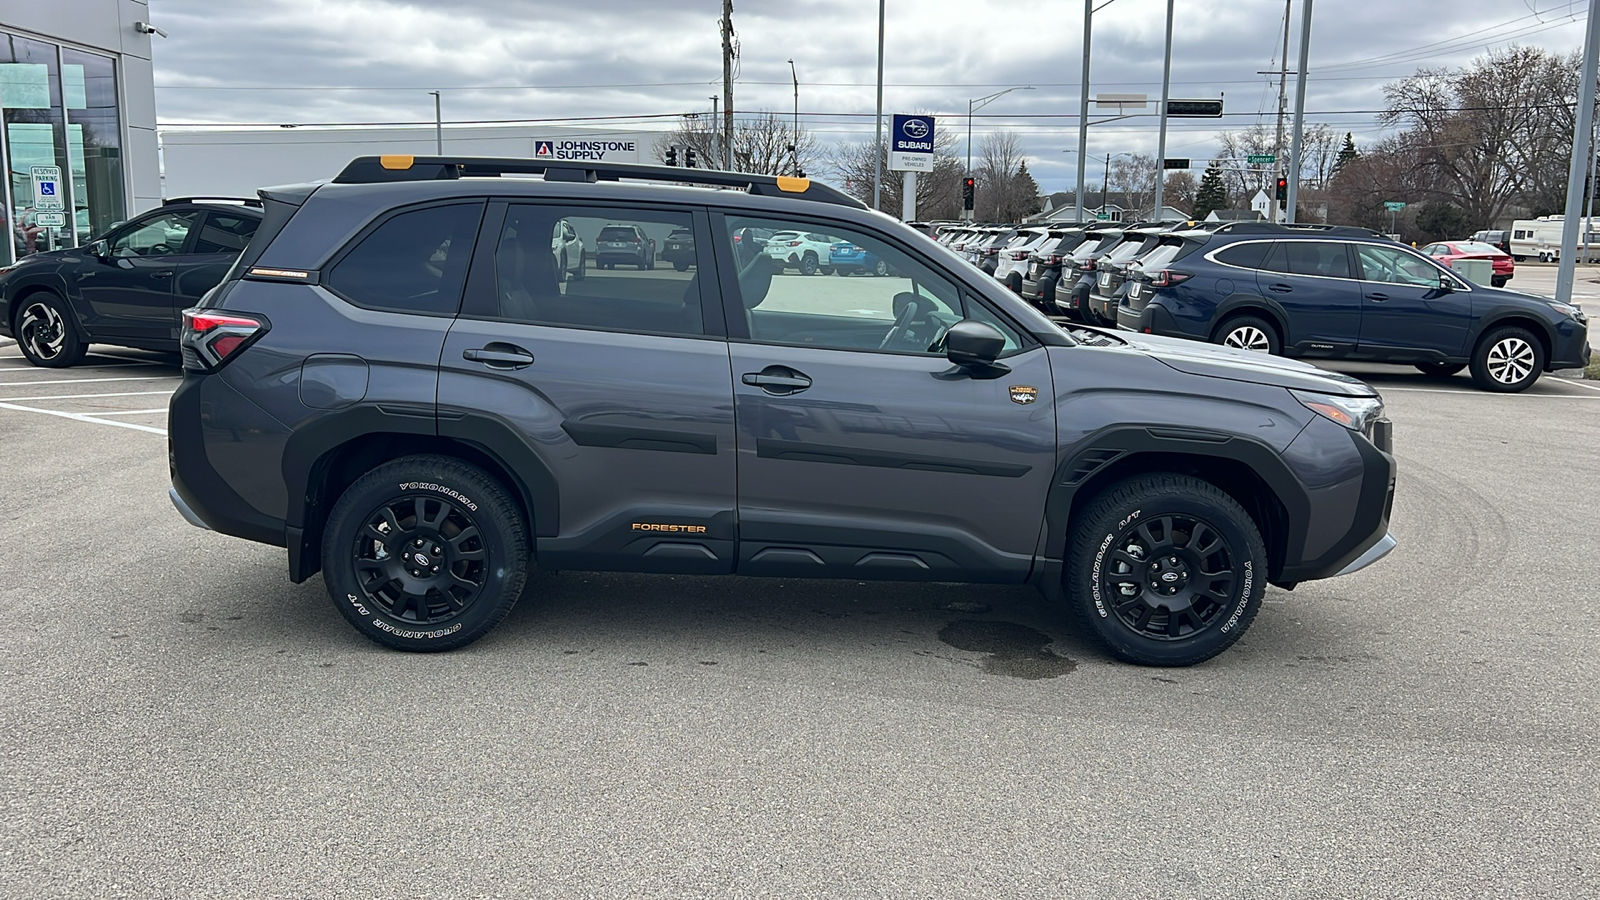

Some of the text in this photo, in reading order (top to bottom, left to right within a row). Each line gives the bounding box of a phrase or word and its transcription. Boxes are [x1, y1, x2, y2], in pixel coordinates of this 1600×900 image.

[556, 141, 635, 151] JOHNSTONE
[897, 140, 932, 150] SUBARU
[538, 146, 547, 155] J
[556, 151, 605, 160] SUPPLY
[399, 482, 478, 512] YOKOHAMA
[632, 523, 706, 533] FORESTER
[1092, 509, 1141, 618] GEOLANDAR A/T
[1220, 560, 1253, 634] YOKOHAMA
[347, 593, 462, 639] GEOLANDAR A/T
